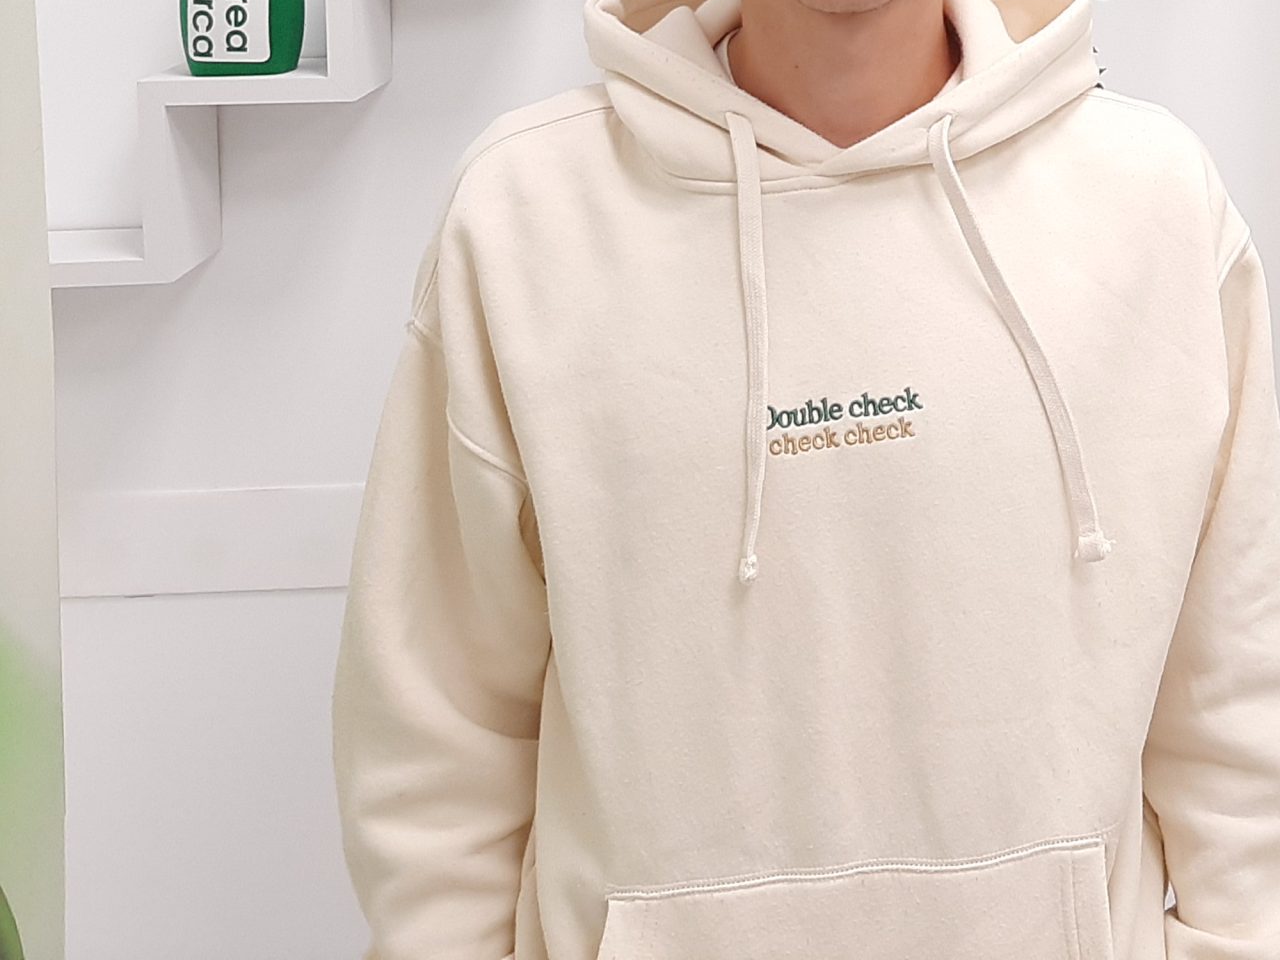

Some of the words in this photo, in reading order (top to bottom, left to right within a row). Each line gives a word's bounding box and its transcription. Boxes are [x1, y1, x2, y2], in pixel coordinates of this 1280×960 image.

[849, 386, 923, 418] check
[769, 426, 841, 456] check
[843, 416, 915, 445] check
